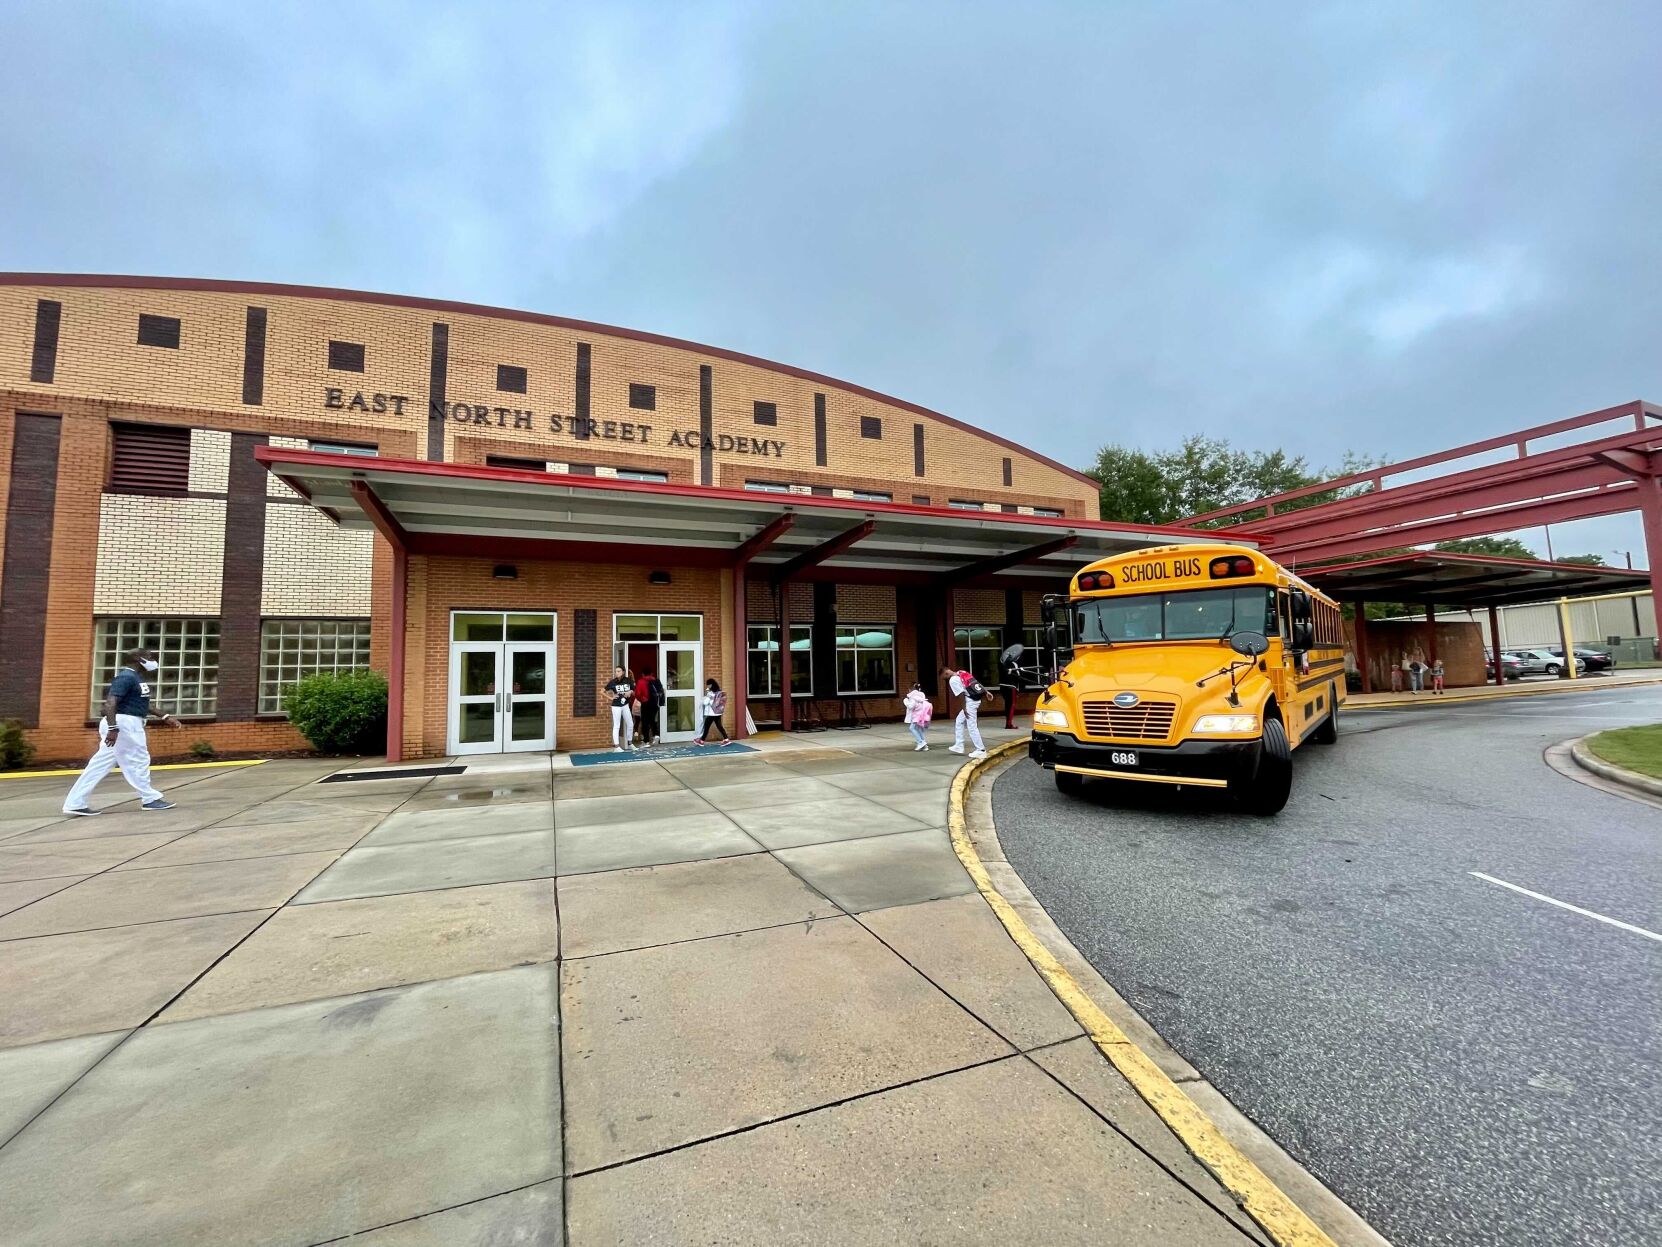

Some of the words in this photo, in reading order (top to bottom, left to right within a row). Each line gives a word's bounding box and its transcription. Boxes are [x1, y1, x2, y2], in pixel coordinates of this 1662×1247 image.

[324, 386, 408, 415] EAST
[429, 400, 533, 430] NORTH
[550, 413, 652, 442] STREET
[667, 429, 786, 457] ACADEMY
[1122, 562, 1170, 583] SCHOOL
[1174, 558, 1202, 578] BUS
[1111, 752, 1136, 765] 688
